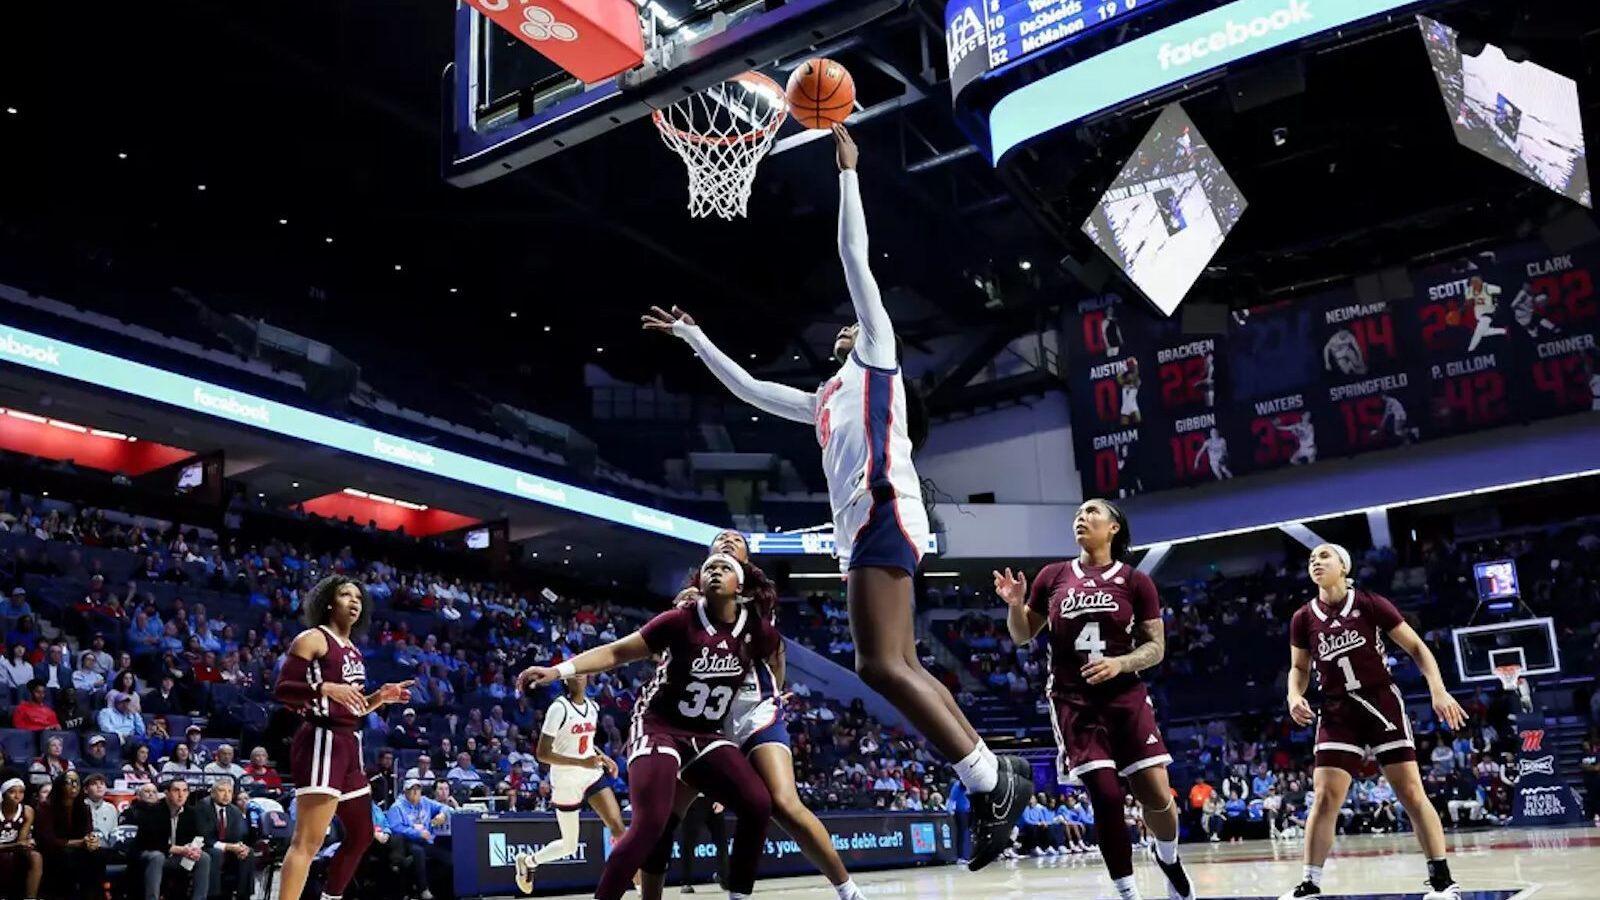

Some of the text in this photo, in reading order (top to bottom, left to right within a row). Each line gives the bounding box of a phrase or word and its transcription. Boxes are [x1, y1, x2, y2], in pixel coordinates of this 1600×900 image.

[990, 0, 1082, 49] 22 DeShields
[991, 49, 1008, 67] 32
[1022, 18, 1085, 53] McMahon
[1098, 2, 1117, 20] 19
[1157, 0, 1313, 70] facebook
[1527, 255, 1573, 277] CLARK
[1429, 278, 1468, 301] SCOTT
[1352, 312, 1397, 360] 14
[1537, 334, 1595, 358] CONNER
[1089, 360, 1128, 380] AUSTIN
[1446, 353, 1497, 376] GILLOM
[1330, 373, 1408, 401] SPRINGFIELD
[193, 387, 270, 423] facebook
[1255, 394, 1303, 415] WATERS
[1093, 429, 1138, 450] GRAHAM
[1060, 587, 1119, 619] State
[1074, 622, 1106, 664] 4
[1318, 630, 1366, 661] State
[691, 647, 744, 679] State
[1338, 656, 1362, 691] 1
[678, 681, 734, 721] 33
[1522, 806, 1567, 816] RESORT
[1525, 800, 1561, 809] RIVER
[851, 832, 876, 849] debit
[878, 831, 903, 848] card?
